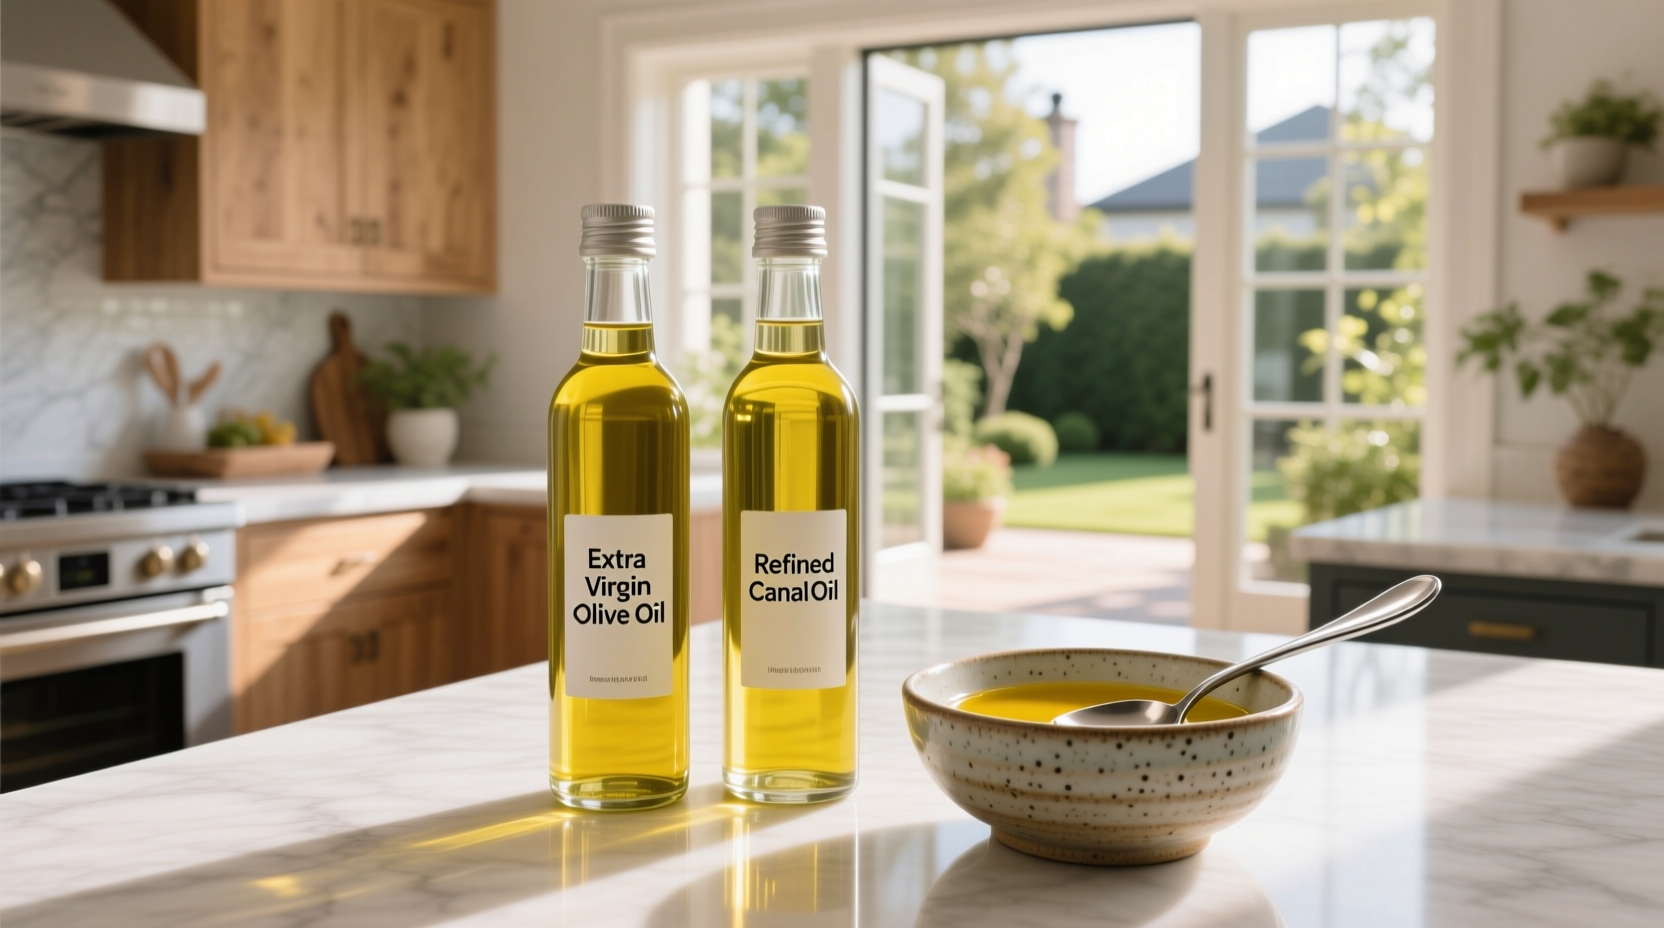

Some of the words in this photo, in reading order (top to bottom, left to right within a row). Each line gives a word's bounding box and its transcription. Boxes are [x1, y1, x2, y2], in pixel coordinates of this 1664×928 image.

[588, 547, 646, 570] Extra
[754, 551, 835, 575] Refined
[584, 575, 651, 602] Virgin
[748, 579, 809, 603] Canal
[810, 579, 839, 602] Oil
[572, 602, 630, 625] Olive
[634, 600, 665, 625] Oil
